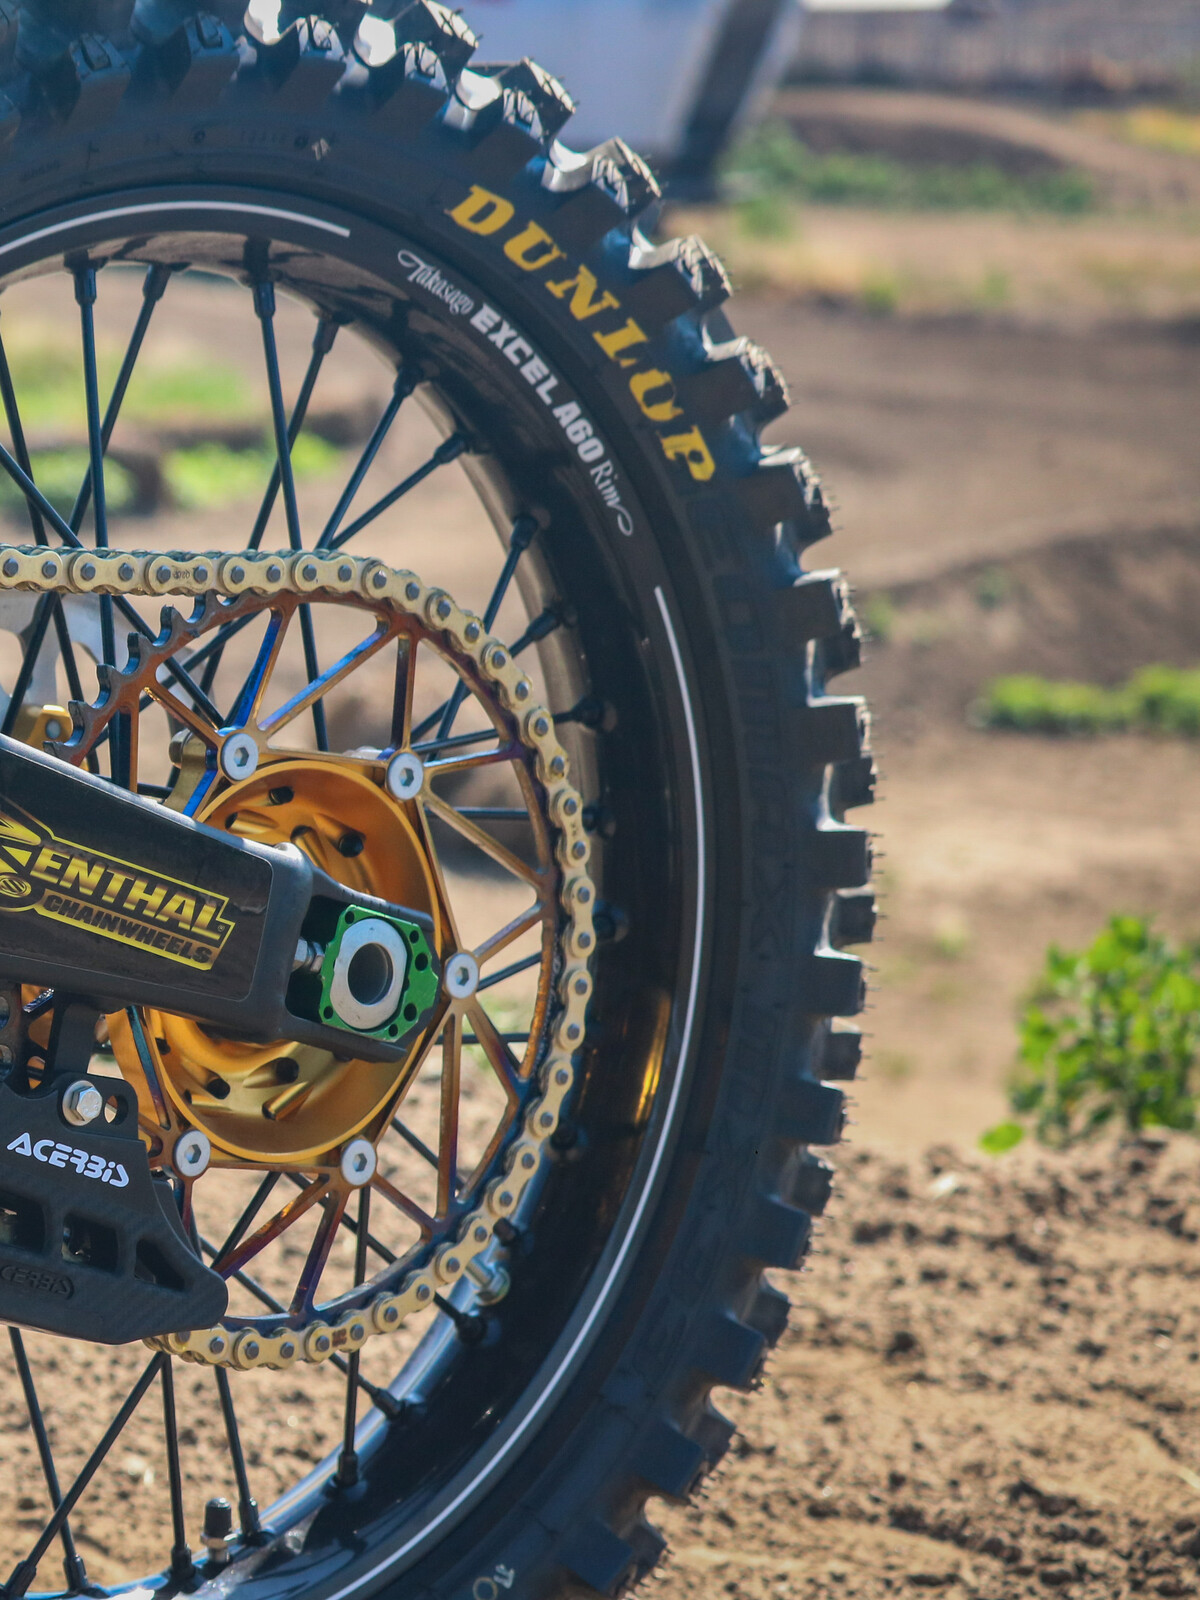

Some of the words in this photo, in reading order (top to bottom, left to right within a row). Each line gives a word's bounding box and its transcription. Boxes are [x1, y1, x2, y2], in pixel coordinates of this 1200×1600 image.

[398, 250, 475, 315] Takasago
[469, 303, 560, 405] EXCEL
[552, 401, 605, 464] A60
[445, 184, 715, 481] DUNLOP
[44, 893, 215, 965] CHAINWHEELS
[6, 1131, 130, 1188] ACERBIS
